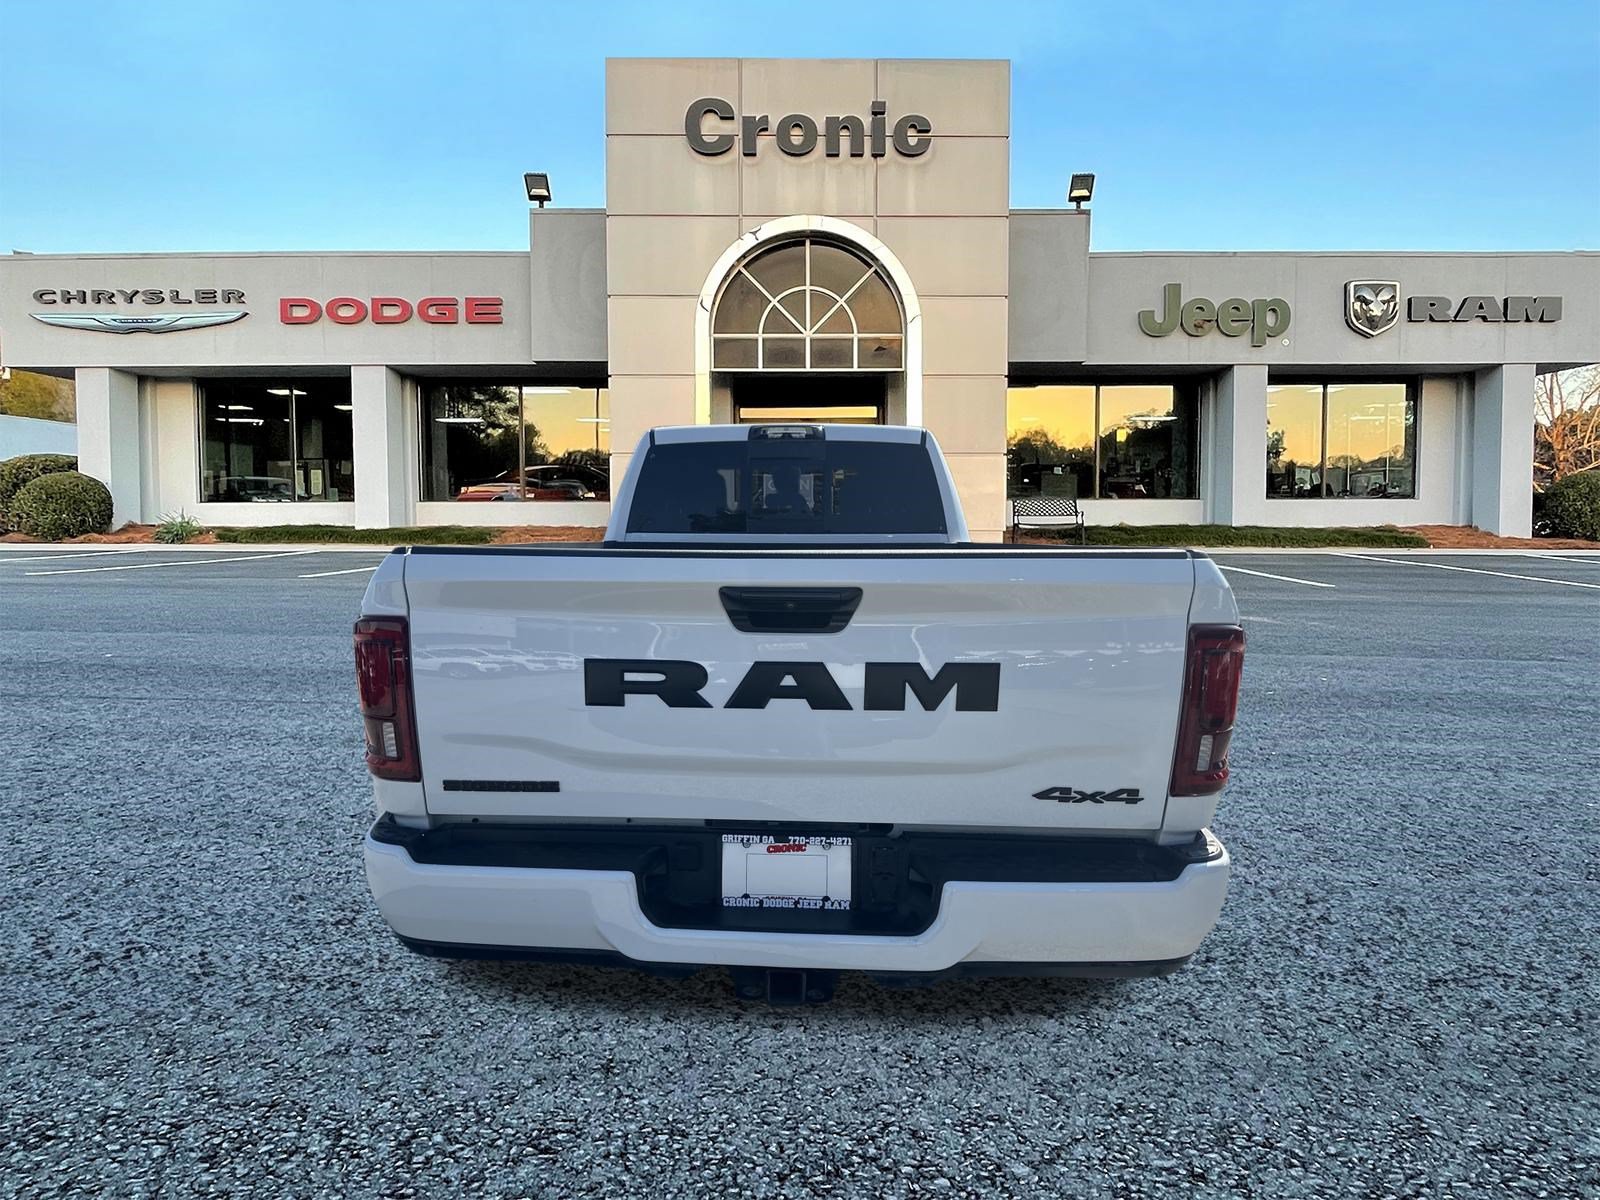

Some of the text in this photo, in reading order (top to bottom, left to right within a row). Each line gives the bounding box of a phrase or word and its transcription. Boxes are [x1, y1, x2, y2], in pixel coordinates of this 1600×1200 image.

[685, 97, 932, 158] Cronic
[32, 287, 246, 305] CHRYSLER
[1407, 295, 1563, 323] RAM
[279, 296, 504, 325] DODGE
[1138, 283, 1291, 347] Jeep
[584, 658, 1001, 712] RAM
[722, 834, 775, 844] GRIFFIN GA
[788, 836, 852, 846] 770-227-4271
[723, 897, 760, 907] CRONIC
[763, 898, 795, 908] DODGE
[797, 900, 823, 909] JEEP
[824, 900, 850, 911] RAM
